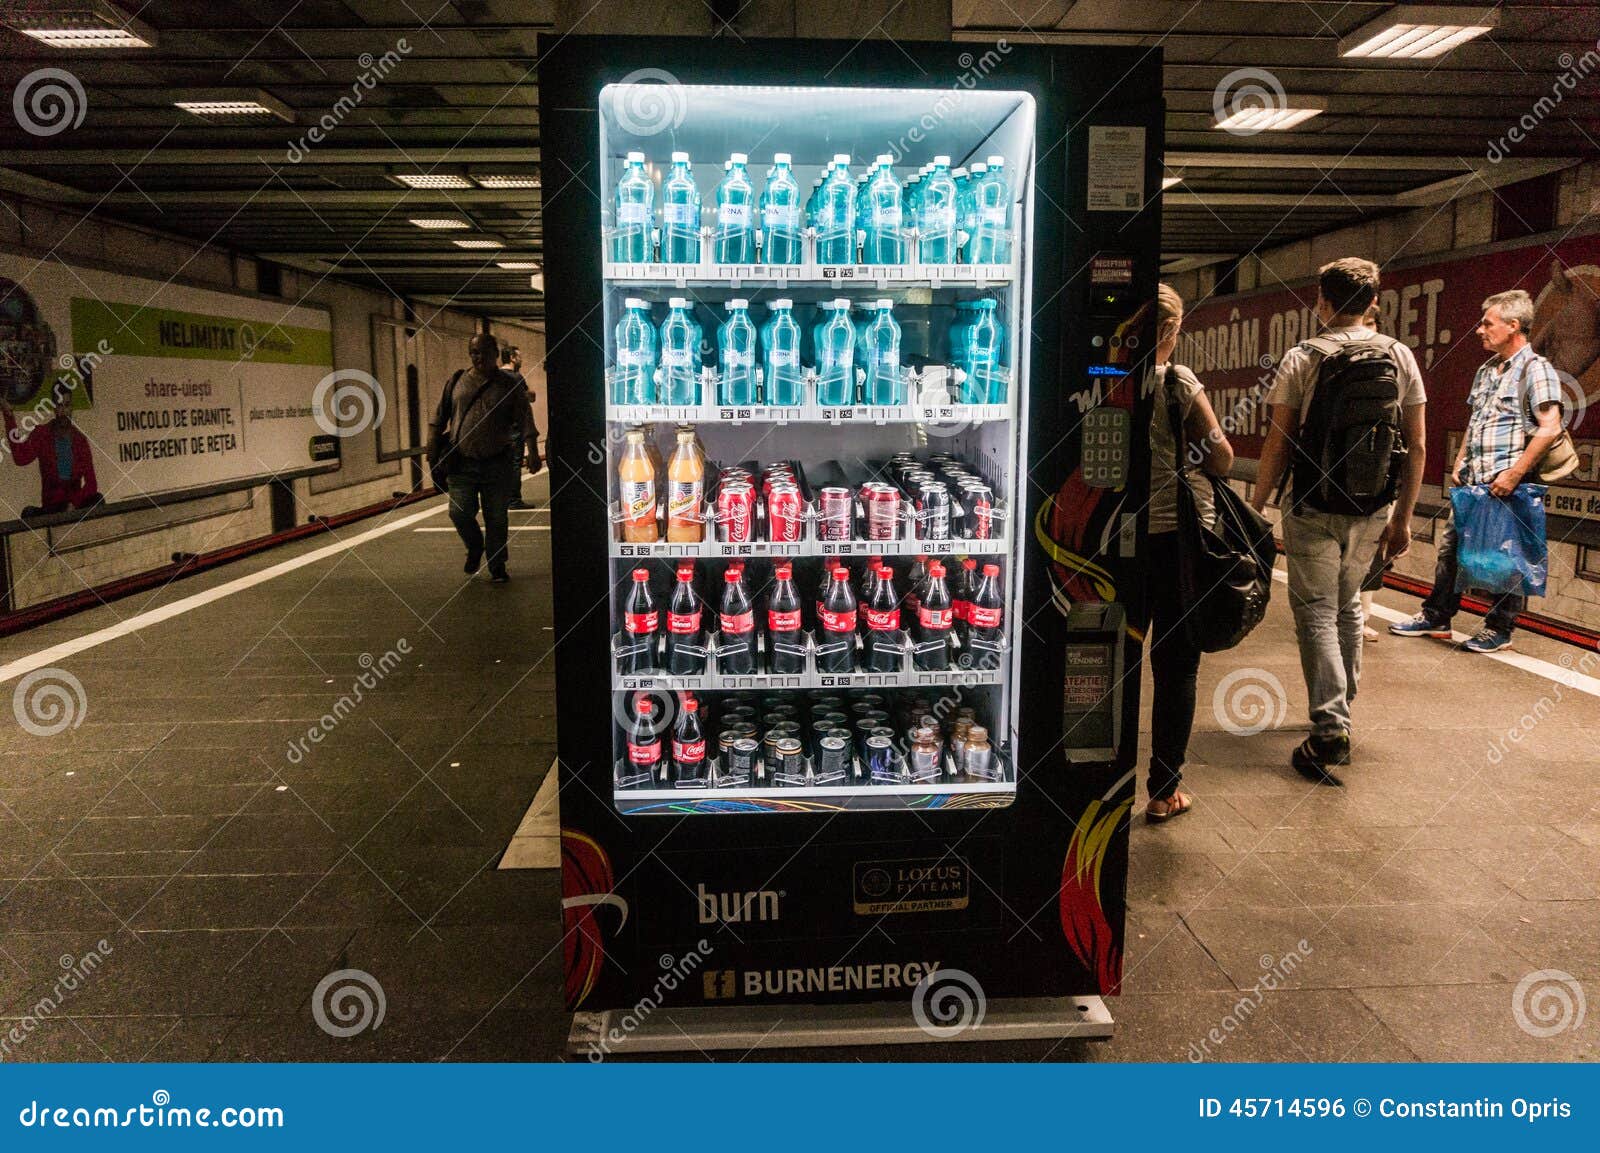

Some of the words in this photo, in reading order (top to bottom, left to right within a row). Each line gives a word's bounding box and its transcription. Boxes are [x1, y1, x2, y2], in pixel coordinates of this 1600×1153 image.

[159, 320, 236, 349] NELIMITAT
[1269, 306, 1318, 363] ORI
[1380, 278, 1451, 370] REȚ.
[117, 411, 170, 431] DINCOLO
[173, 409, 187, 428] DE
[119, 438, 188, 462] INDIFERENT
[191, 437, 205, 454] DE
[1555, 495, 1582, 512] ceva
[897, 866, 960, 881] LOTUS
[921, 882, 961, 893] TEAM
[869, 903, 909, 913] OFFICIAL
[911, 901, 954, 911] PARTNER
[744, 961, 940, 996] BURNENERGY
